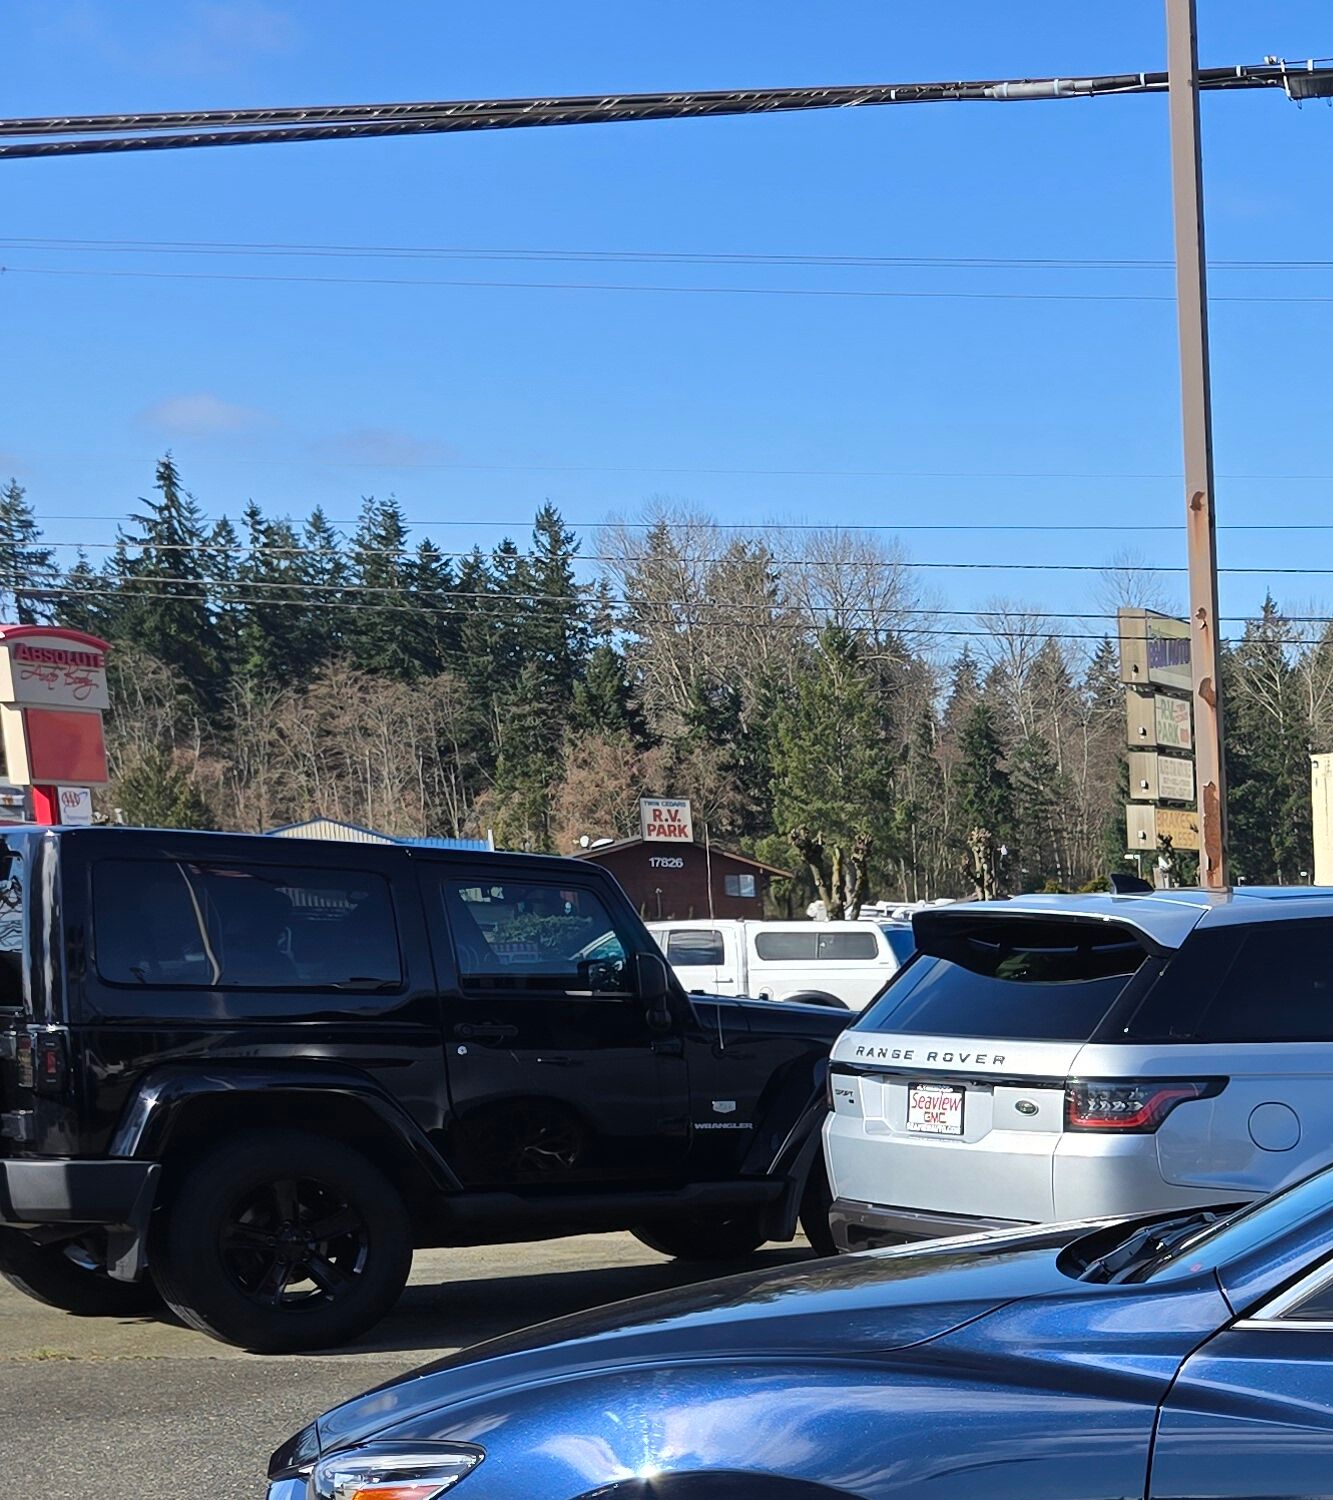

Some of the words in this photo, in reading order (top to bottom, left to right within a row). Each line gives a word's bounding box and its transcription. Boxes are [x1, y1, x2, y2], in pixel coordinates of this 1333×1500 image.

[14, 643, 105, 668] ABSOLUTE
[652, 808, 682, 822] R.V.
[647, 823, 689, 838] PARK
[649, 857, 684, 868] 17826
[856, 1046, 914, 1060] RANGE
[926, 1051, 1006, 1065] ROVER
[911, 1092, 961, 1111] Seaview
[924, 1111, 946, 1124] GMC
